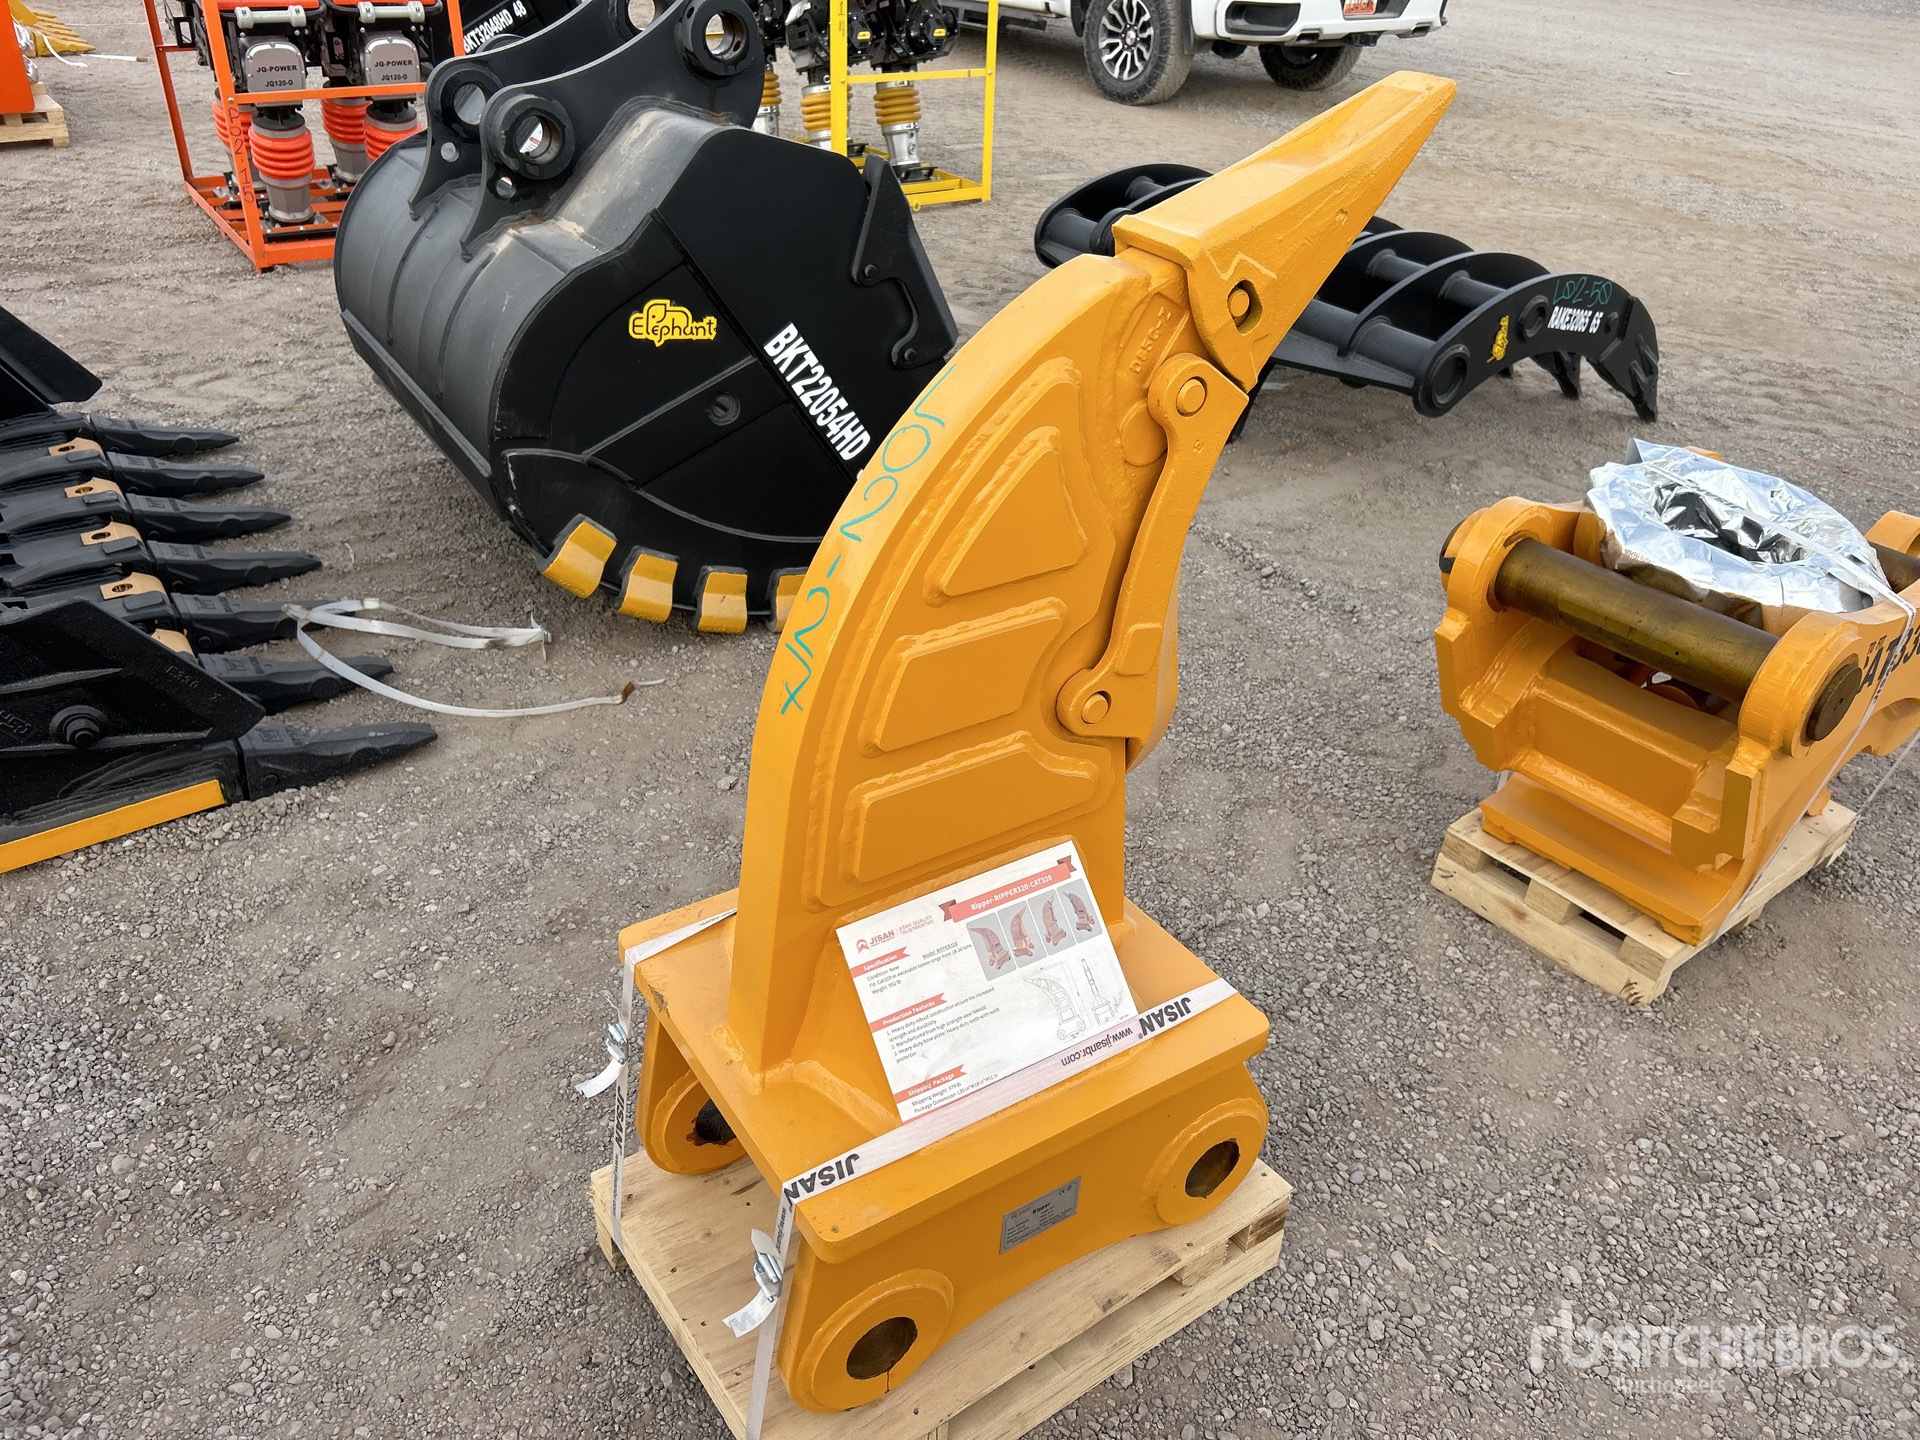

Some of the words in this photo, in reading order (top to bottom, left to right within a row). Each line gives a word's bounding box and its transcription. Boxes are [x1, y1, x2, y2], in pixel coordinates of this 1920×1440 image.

[512, 0, 527, 17] 48
[256, 65, 298, 73] JQ-POWER
[630, 301, 717, 345] Elephant
[764, 322, 871, 461] BKT22054HD
[869, 930, 895, 945] JISAN
[863, 955, 897, 972] Specification
[883, 1011, 912, 1026] Production
[912, 1001, 935, 1014] Features
[1061, 1027, 1133, 1066] www.jisanbr.com
[908, 1083, 932, 1097] Shipping
[933, 1074, 955, 1087] Package
